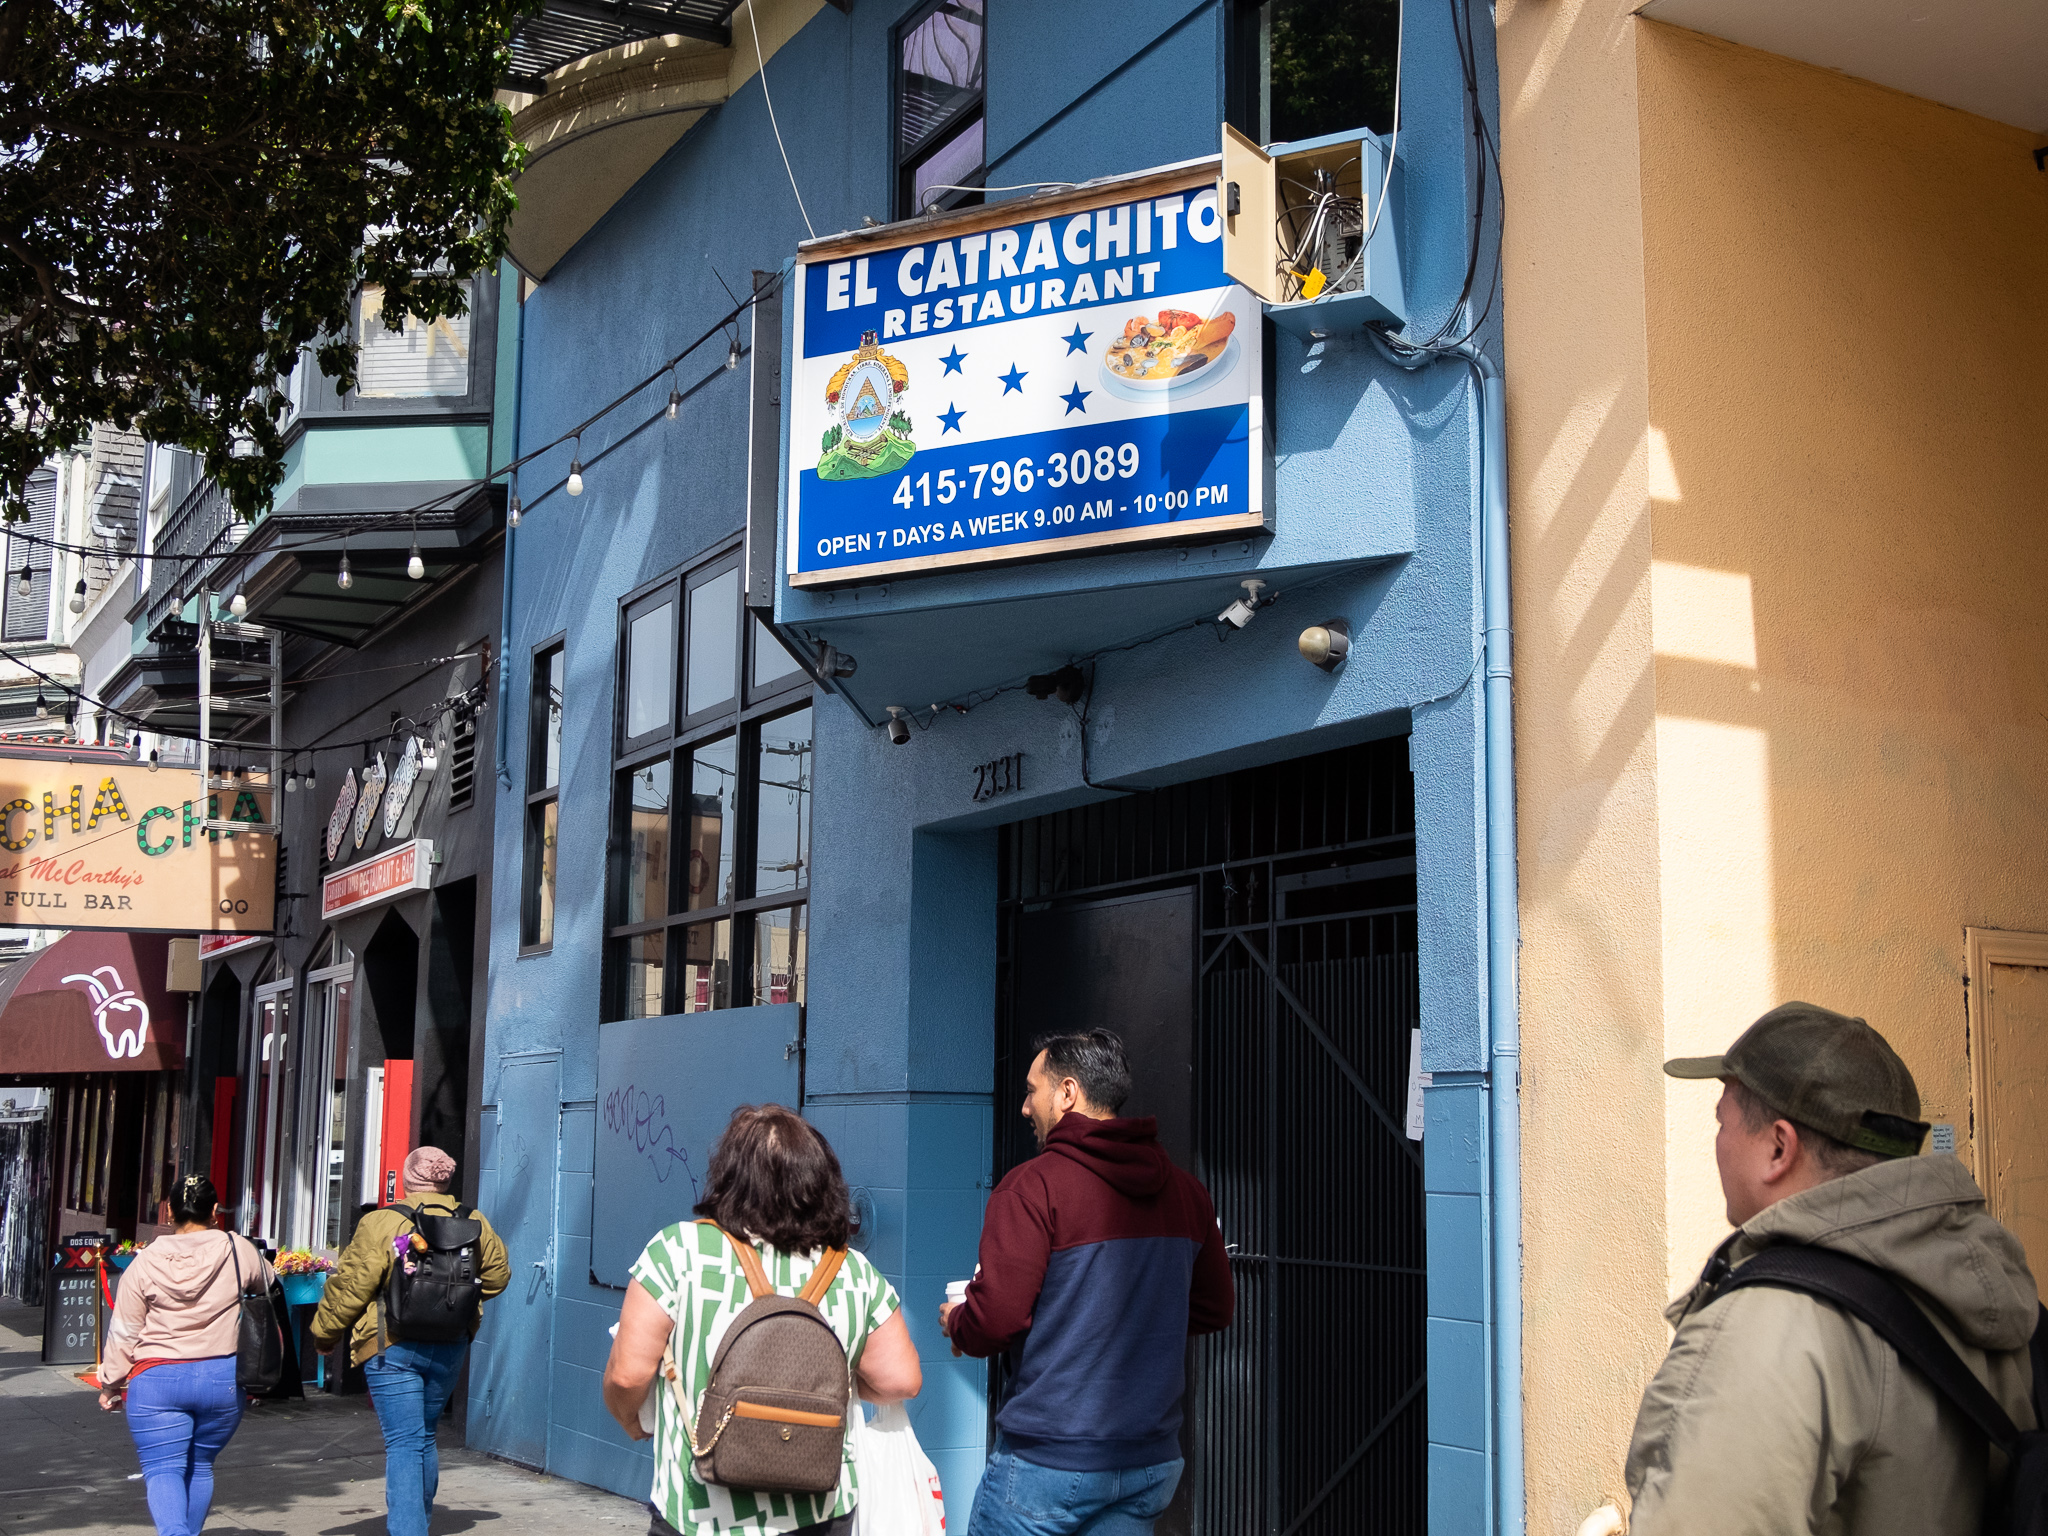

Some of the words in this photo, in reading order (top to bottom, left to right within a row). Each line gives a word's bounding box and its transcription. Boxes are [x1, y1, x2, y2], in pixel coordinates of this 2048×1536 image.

[827, 258, 877, 312] EL
[898, 189, 1222, 297] CATRACHITO
[883, 261, 1161, 339] RESTAURANT
[817, 533, 871, 557] OPEN
[876, 531, 887, 549] 7
[893, 523, 945, 548] DAYS
[950, 520, 965, 540] A
[968, 510, 1029, 537] WEEK
[1080, 499, 1114, 521] AM
[1195, 484, 1228, 507] PM
[972, 753, 1025, 802] 2331
[0, 777, 130, 850] CHA
[137, 792, 265, 856] CHA
[29, 856, 144, 890] McCarthy's
[359, 860, 394, 897] RESTAURANT
[401, 851, 414, 882] BAR
[4, 891, 67, 909] FULL
[83, 894, 133, 911] BAR
[70, 1238, 83, 1246] DOS
[66, 1332, 95, 1347] OF
